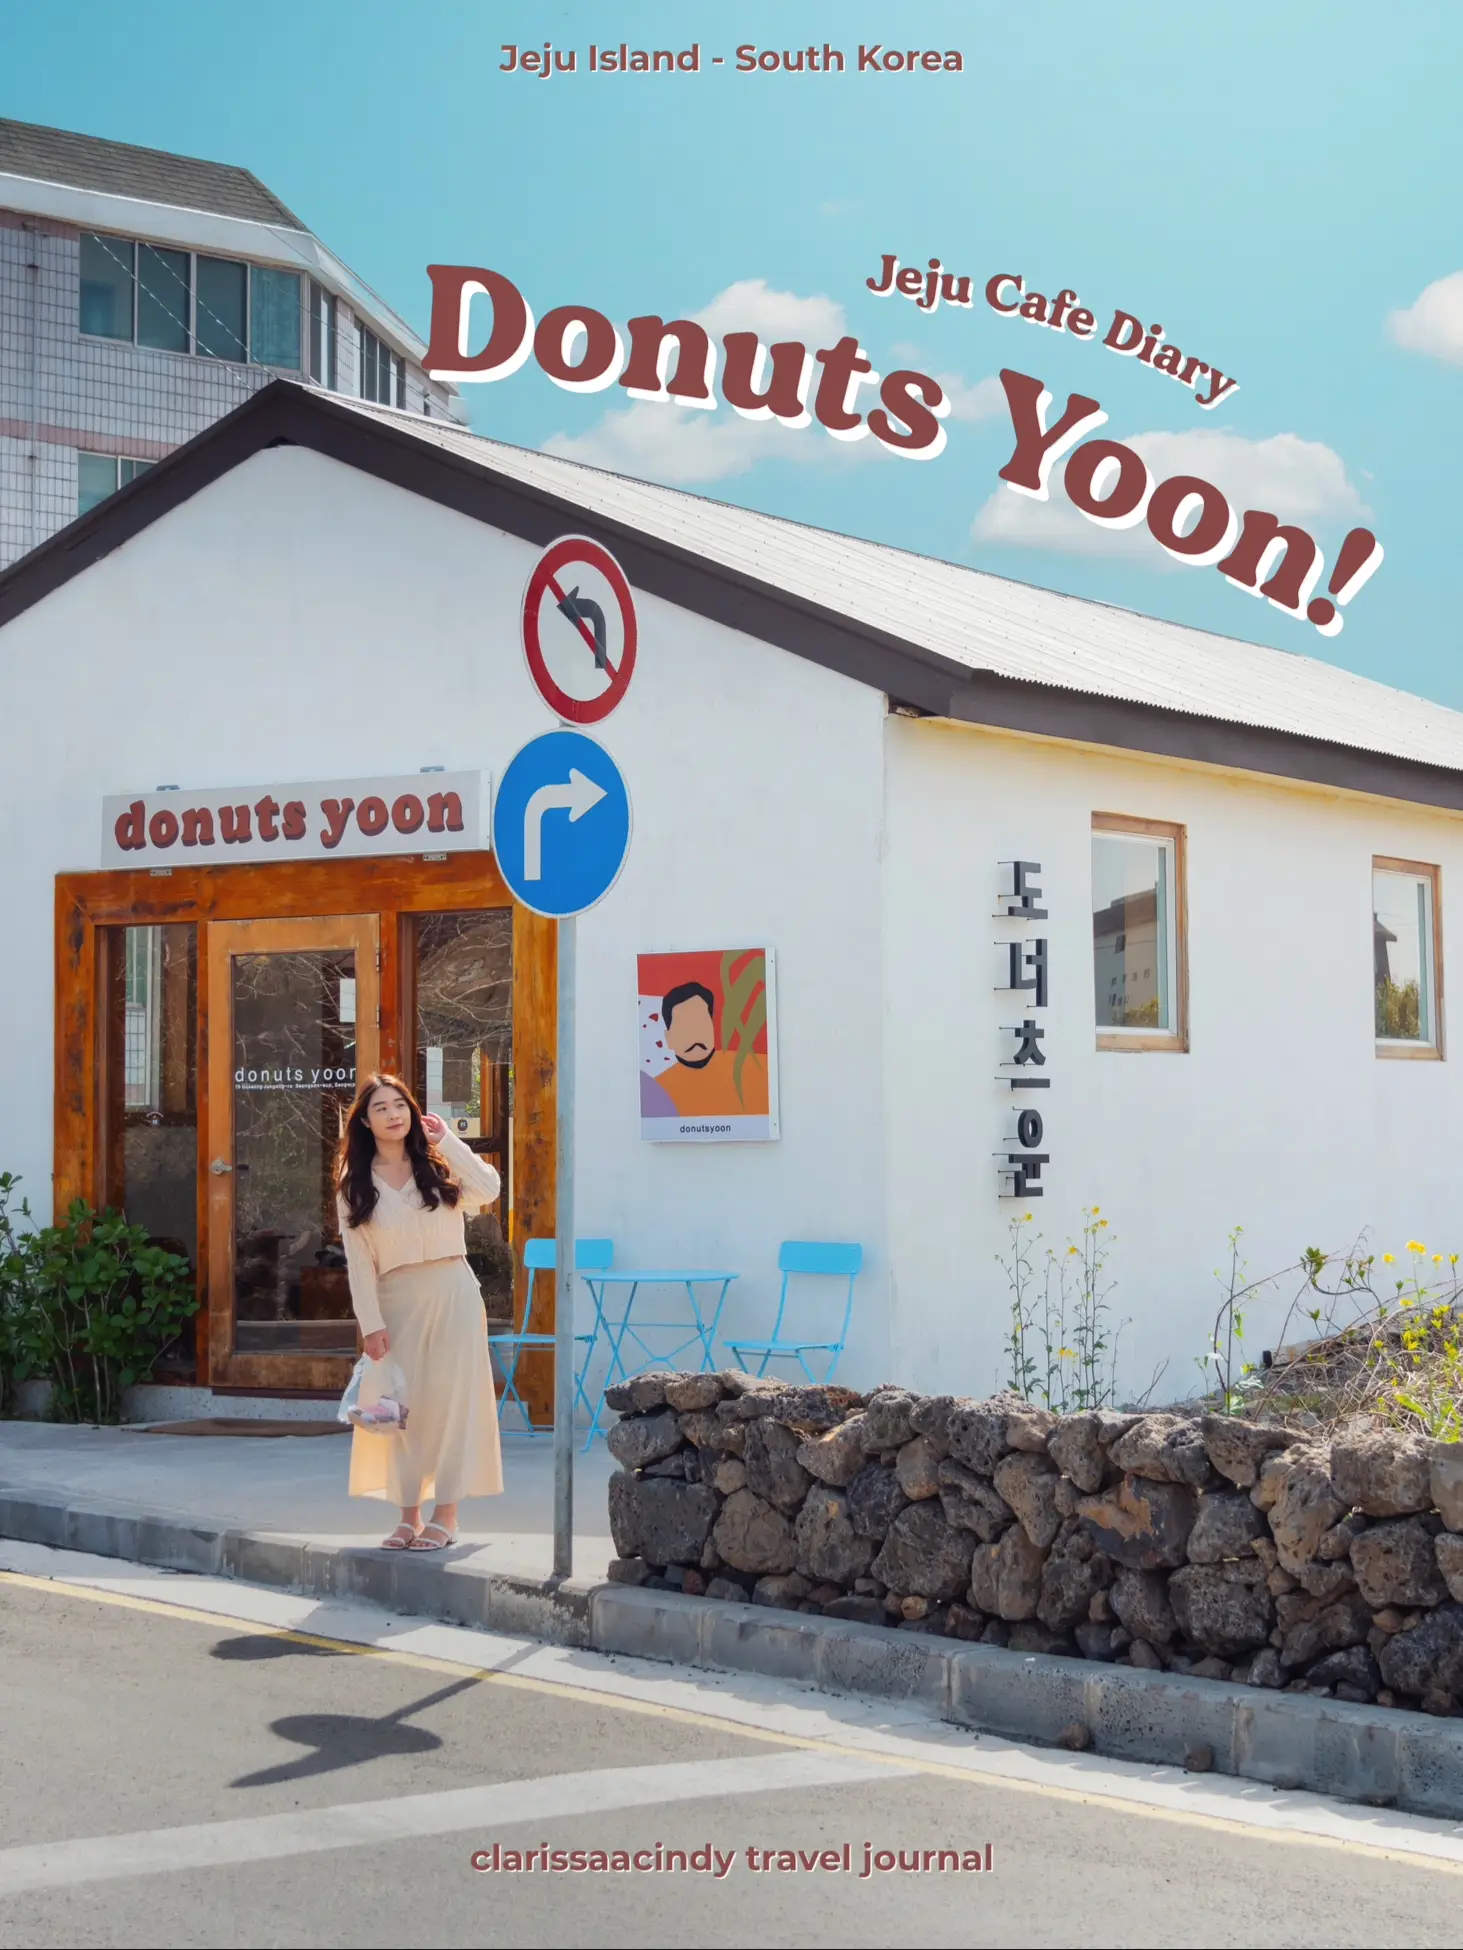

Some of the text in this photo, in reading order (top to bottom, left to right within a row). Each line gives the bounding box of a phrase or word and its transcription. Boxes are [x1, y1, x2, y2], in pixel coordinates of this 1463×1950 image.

[114, 790, 464, 851] donuts yoon
[1008, 860, 1051, 1198] 도너츠윤
[234, 1066, 304, 1082] donuts
[679, 1124, 732, 1134] donutsyoon
